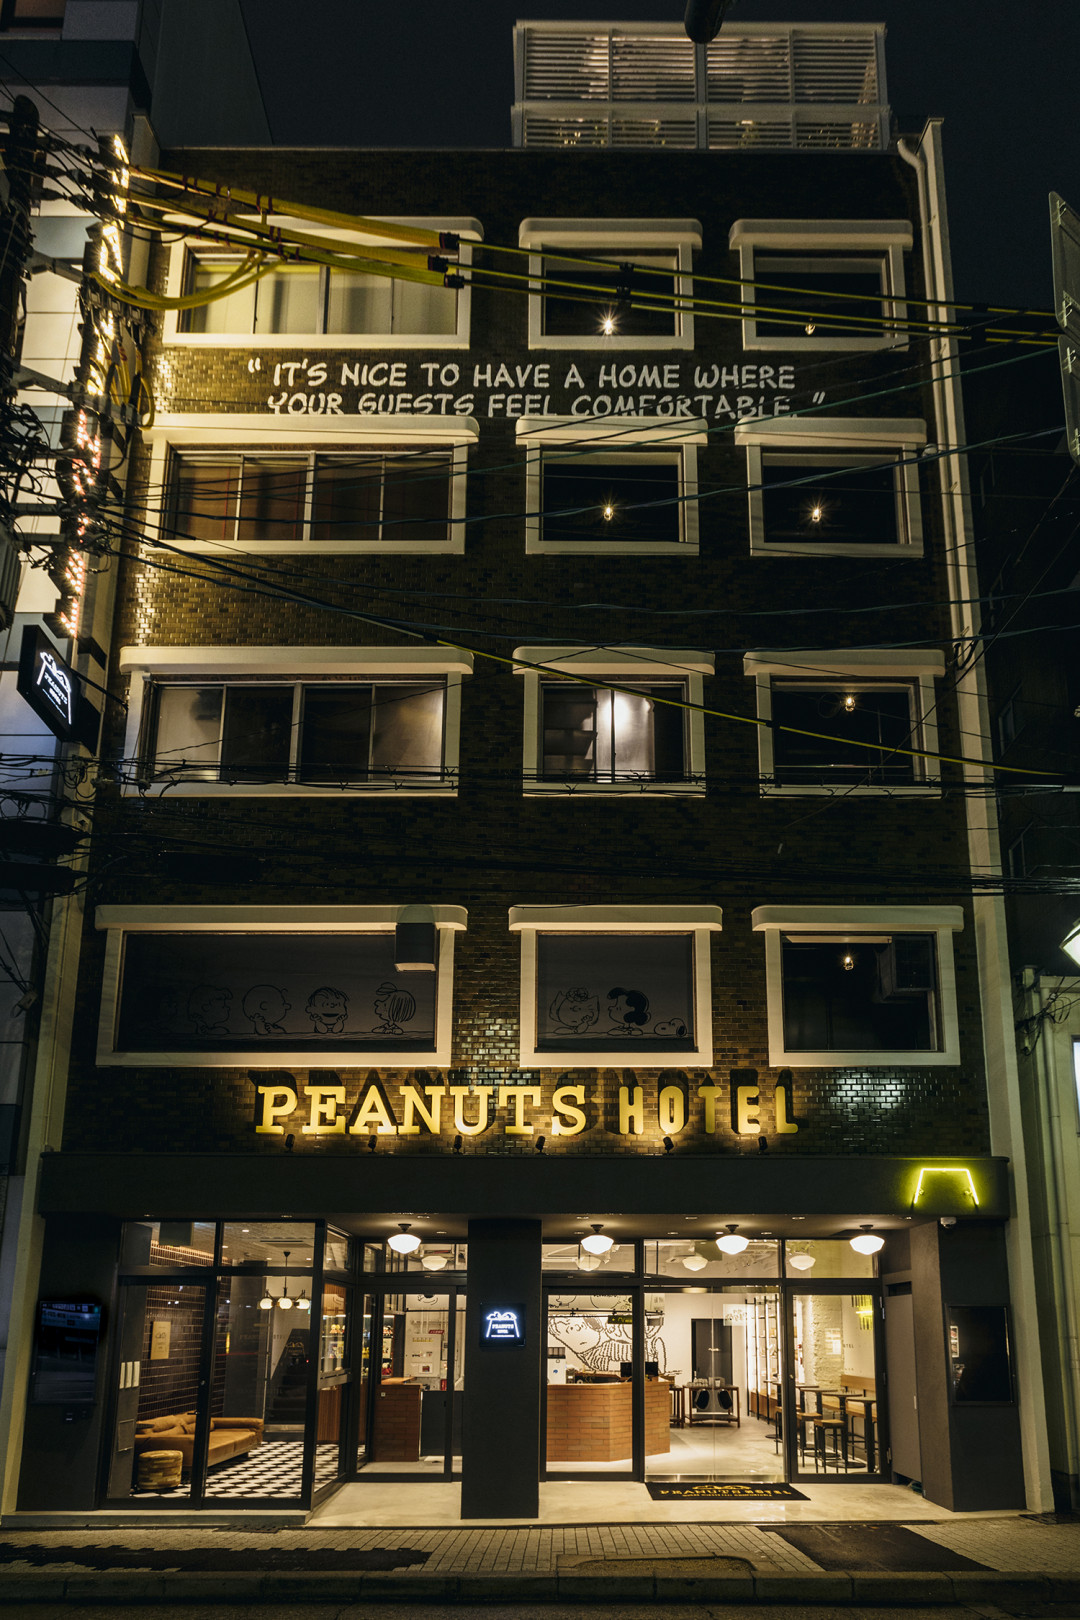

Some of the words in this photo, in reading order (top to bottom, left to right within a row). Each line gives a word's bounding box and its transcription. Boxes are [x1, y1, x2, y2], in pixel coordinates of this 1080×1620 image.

[340, 363, 407, 387] NICE
[420, 363, 461, 387] TO
[472, 364, 551, 388] HAVE
[563, 364, 585, 389] A
[598, 364, 680, 389] HOME
[693, 364, 796, 389] WHERE
[267, 392, 345, 415] YOUR
[357, 393, 475, 416] GUESTS
[487, 394, 557, 416] FEEL
[255, 1084, 588, 1136] PEANUTS
[617, 1085, 799, 1136] HOTEL
